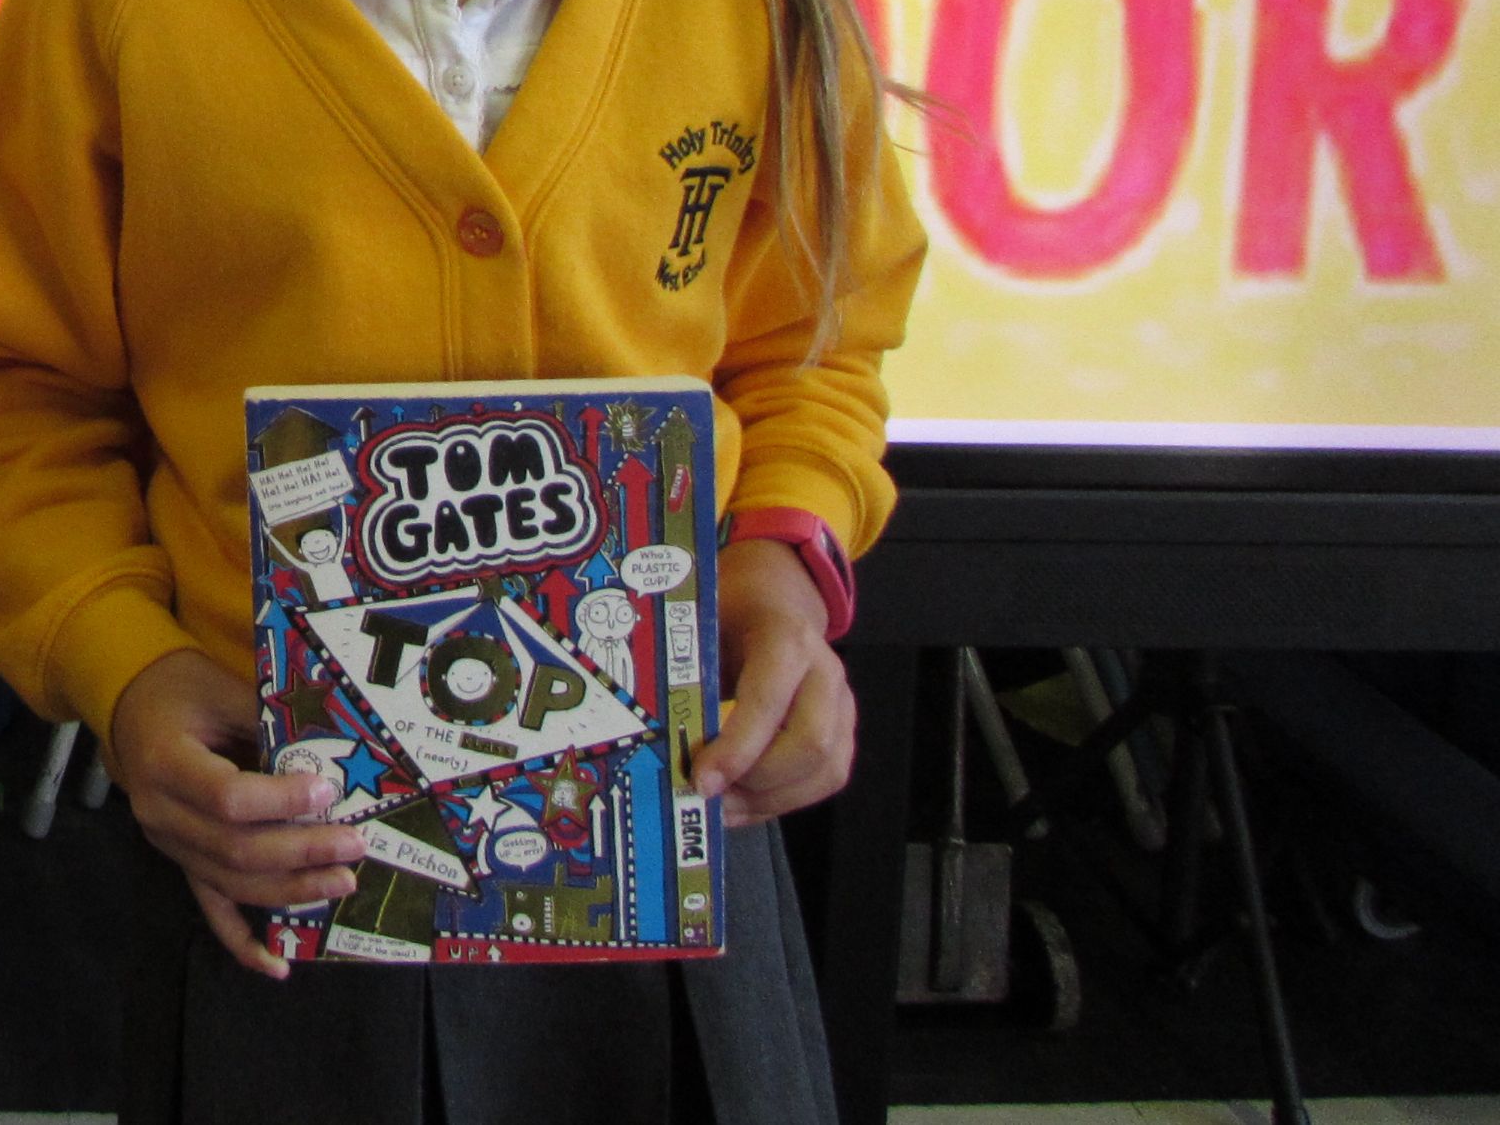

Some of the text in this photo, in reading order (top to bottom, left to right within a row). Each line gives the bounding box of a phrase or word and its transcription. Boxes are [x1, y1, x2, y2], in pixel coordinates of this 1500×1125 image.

[659, 126, 706, 171] Holy
[388, 433, 545, 500] TOM
[381, 482, 576, 563] GATES
[632, 562, 680, 573] PLASTIC
[640, 548, 672, 559] Who's
[360, 608, 587, 732] TOP
[395, 719, 416, 733] OF
[425, 726, 454, 743] THE
[415, 746, 468, 775] (nearly)
[396, 842, 459, 880] Pichon
